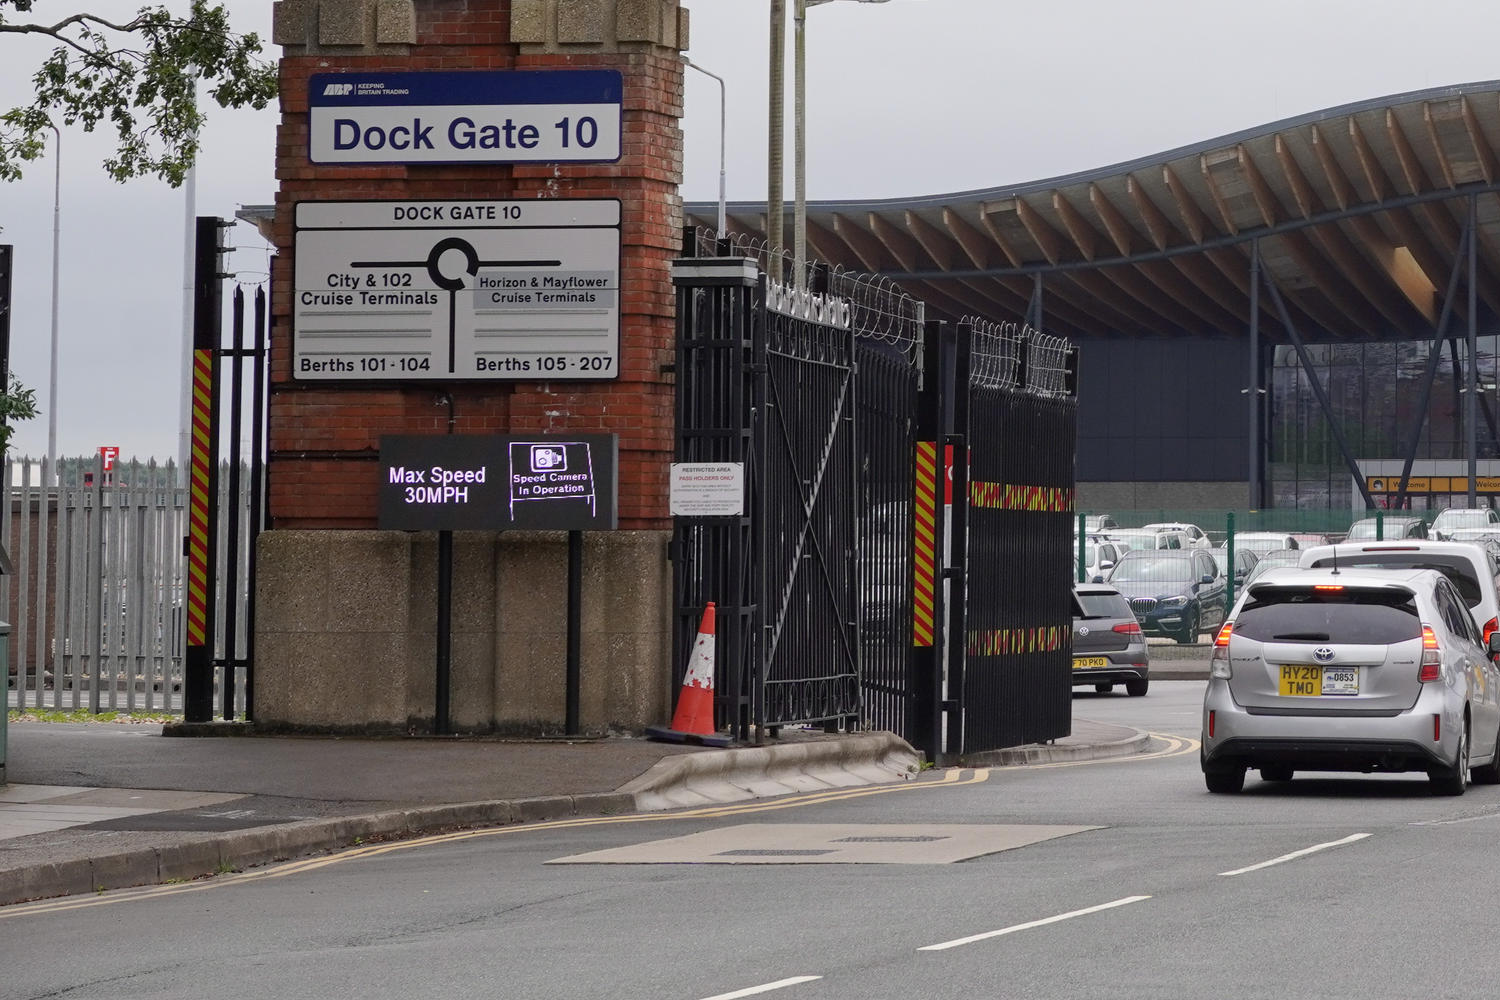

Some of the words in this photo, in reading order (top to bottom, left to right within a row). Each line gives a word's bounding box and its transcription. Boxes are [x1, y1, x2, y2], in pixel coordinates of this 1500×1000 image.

[323, 84, 353, 95] ABP
[334, 118, 435, 150] Dock
[448, 117, 540, 149] Gate
[555, 116, 598, 148] 10
[394, 207, 444, 220] DOCK
[450, 206, 496, 220] GATE
[503, 206, 521, 219] 10
[327, 273, 360, 290] City
[366, 274, 376, 287] &
[382, 273, 412, 287] 102
[480, 277, 527, 288] Horizon
[531, 277, 539, 288] &
[543, 276, 608, 289] Mayflower
[301, 292, 353, 305] Cruise
[360, 291, 438, 305] Terminals
[492, 292, 531, 303] Cruise
[536, 291, 596, 302] Terminals
[300, 358, 354, 372] Berths
[360, 358, 385, 371] 101
[400, 357, 430, 371] 104
[476, 358, 530, 371] Berths
[536, 357, 566, 371] 105
[580, 357, 612, 370] 207
[105, 451, 115, 468] F
[389, 467, 425, 484] Max
[430, 466, 486, 487] Speed
[513, 474, 546, 484] Speed
[550, 473, 588, 482] Camera
[405, 486, 468, 504] 30MPH
[519, 486, 529, 495] In
[532, 484, 585, 495] Operation
[1283, 666, 1318, 680] HY20
[1334, 673, 1354, 682] 0853
[1288, 682, 1313, 694] TMO
